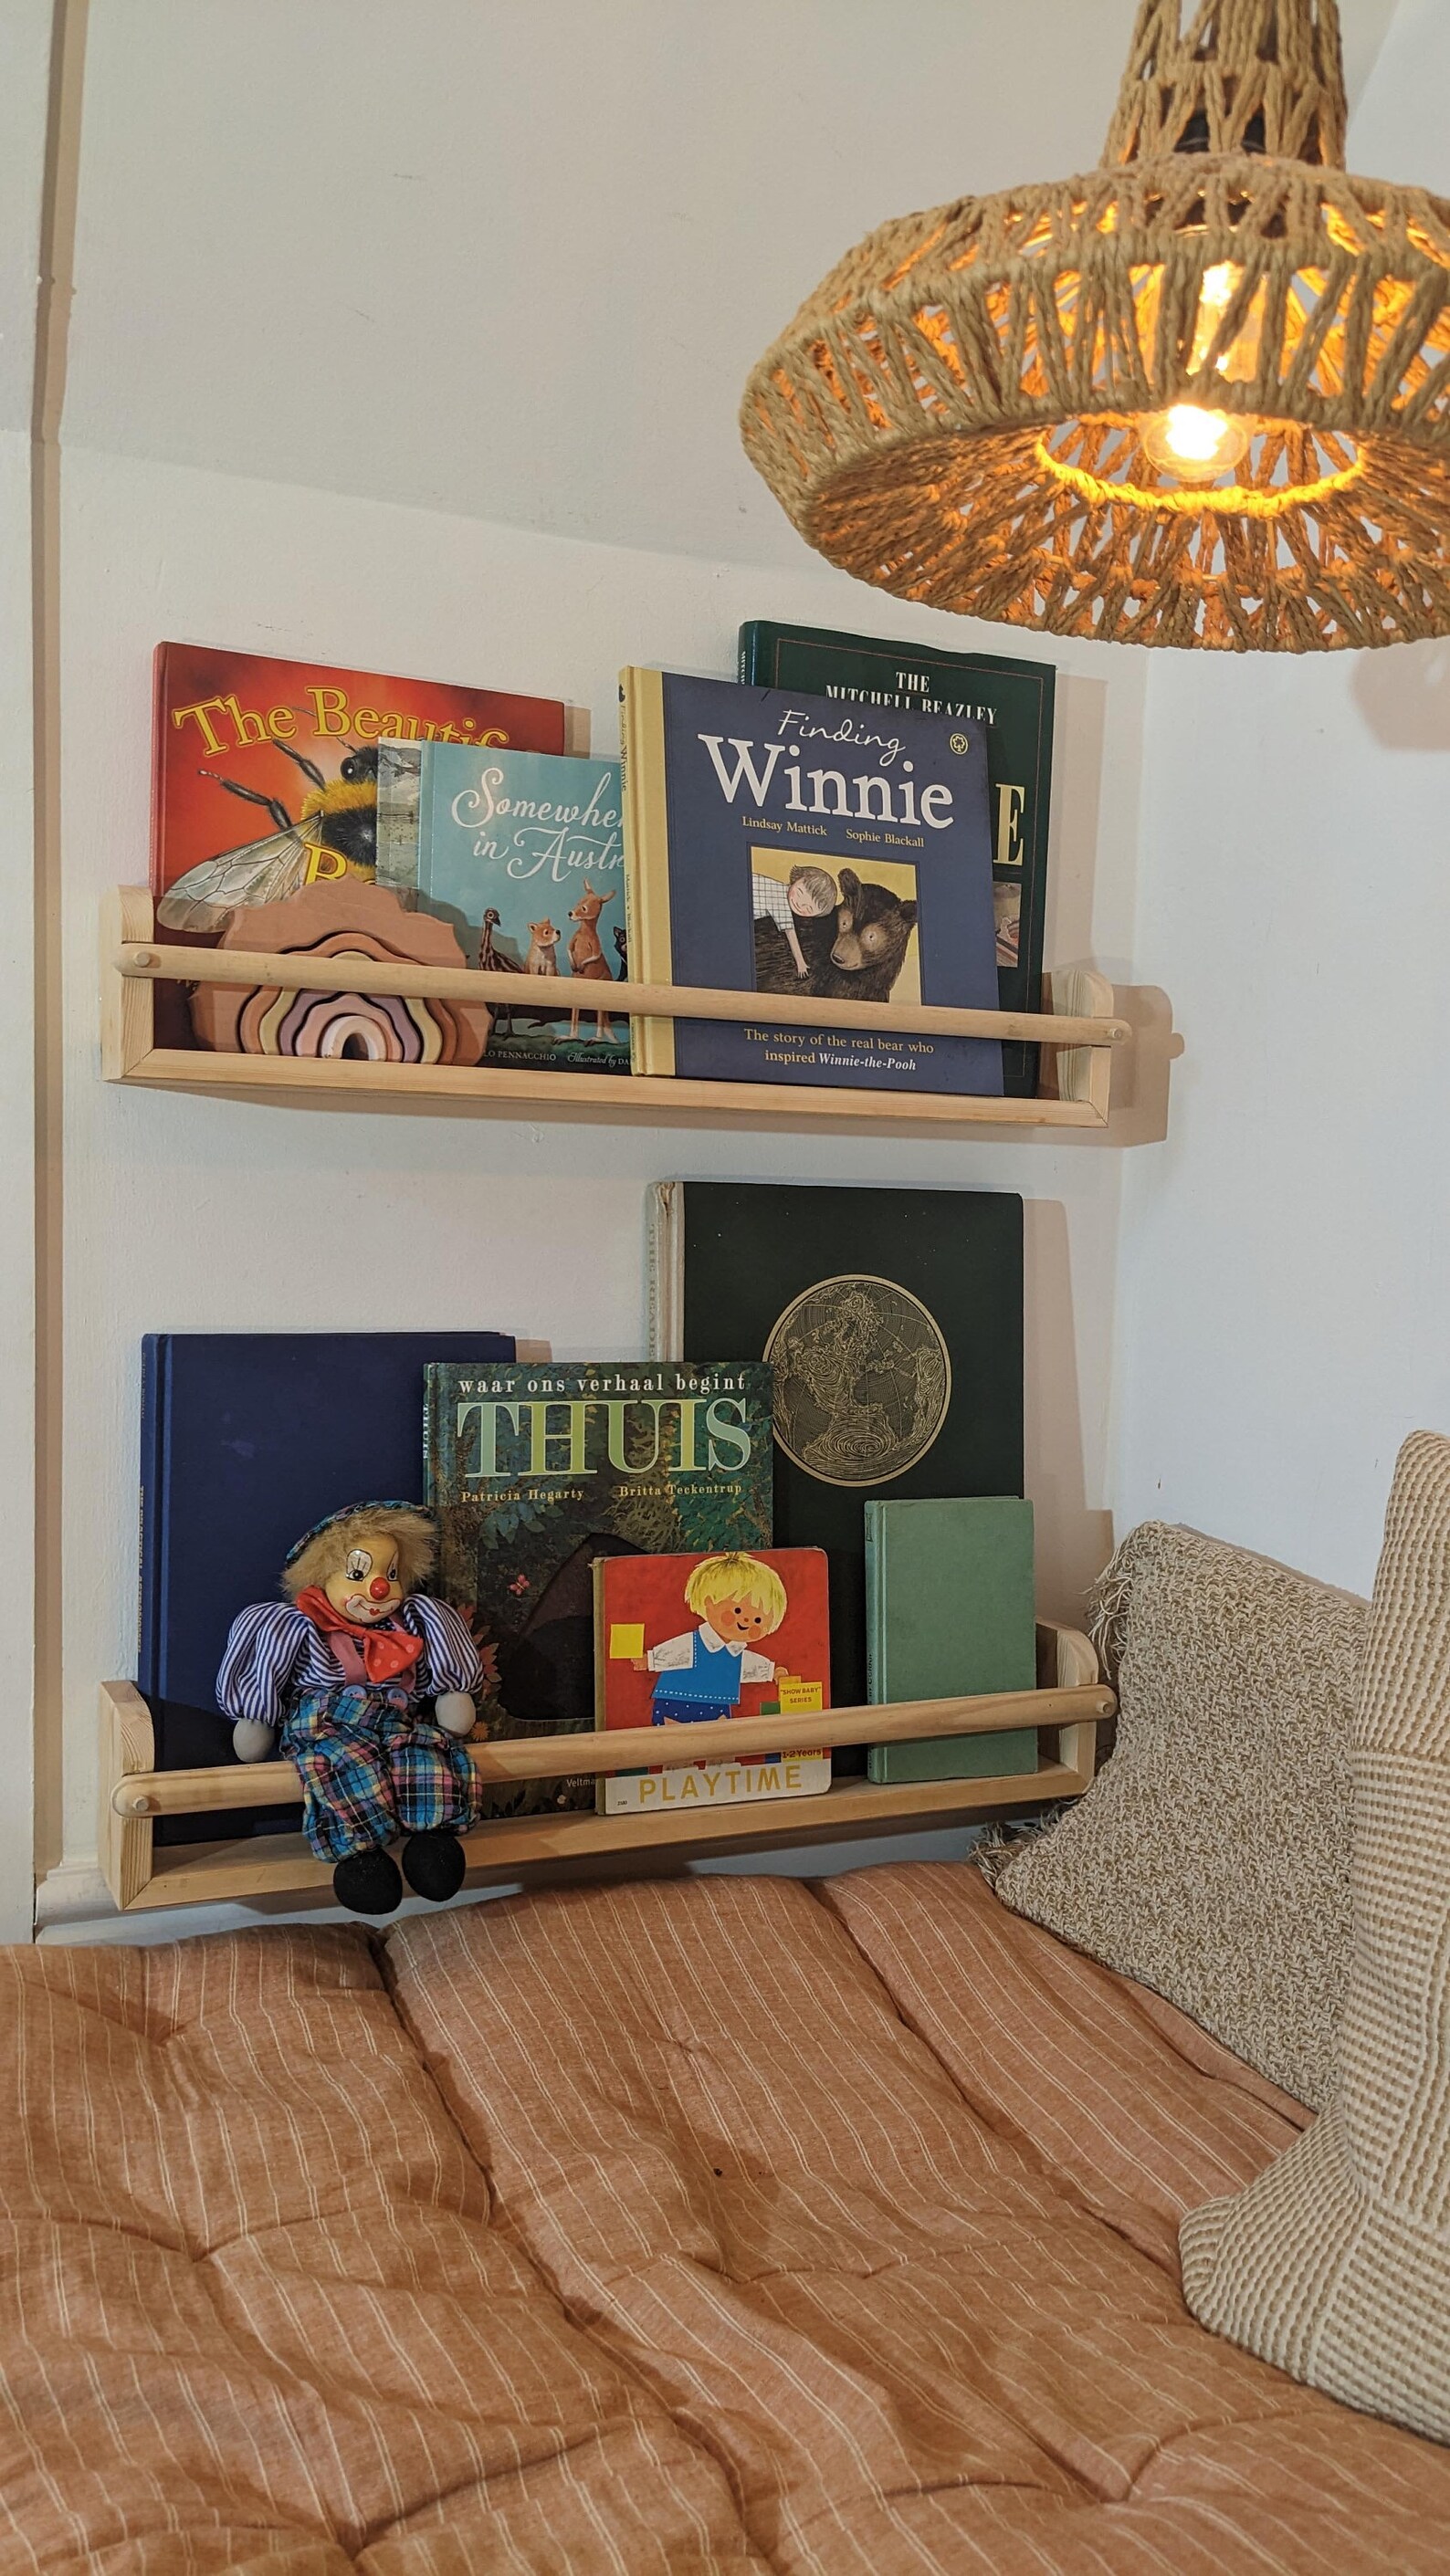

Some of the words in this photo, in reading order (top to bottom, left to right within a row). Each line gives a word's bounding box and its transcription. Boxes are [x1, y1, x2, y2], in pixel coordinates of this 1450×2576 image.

[895, 671, 930, 694] THE
[825, 685, 911, 710] MITCHELL
[173, 694, 298, 757] The
[777, 709, 906, 767] Finding
[697, 733, 954, 829] Winnie
[741, 816, 783, 833] Lindsay
[786, 822, 828, 837] Mattick
[472, 831, 509, 860] in
[846, 828, 881, 844] Sophie
[884, 832, 925, 849] Blackall
[744, 1028, 769, 1042] The
[773, 1032, 805, 1047] story
[810, 1033, 825, 1046] of
[827, 1035, 847, 1048] the
[851, 1037, 874, 1050] real
[877, 1039, 903, 1052] bear
[908, 1042, 935, 1053] who
[497, 1051, 557, 1062] PENNACCHIO
[764, 1050, 815, 1065] inspired
[818, 1052, 917, 1071] Winnie-the-Pooh
[457, 1378, 516, 1394] waar
[527, 1378, 566, 1393] ons
[577, 1375, 665, 1392] verhaal
[676, 1373, 746, 1395] begint
[457, 1397, 751, 1479] THUIS
[460, 1489, 521, 1503] Patricia
[528, 1488, 585, 1503] Hegarty
[618, 1485, 663, 1498] Britta
[667, 1482, 742, 1497] Teckentrup
[789, 1696, 812, 1704] SERIES
[802, 1686, 822, 1694] BABY"
[796, 1748, 822, 1757] Years
[639, 1764, 803, 1805] PLAYTIME
